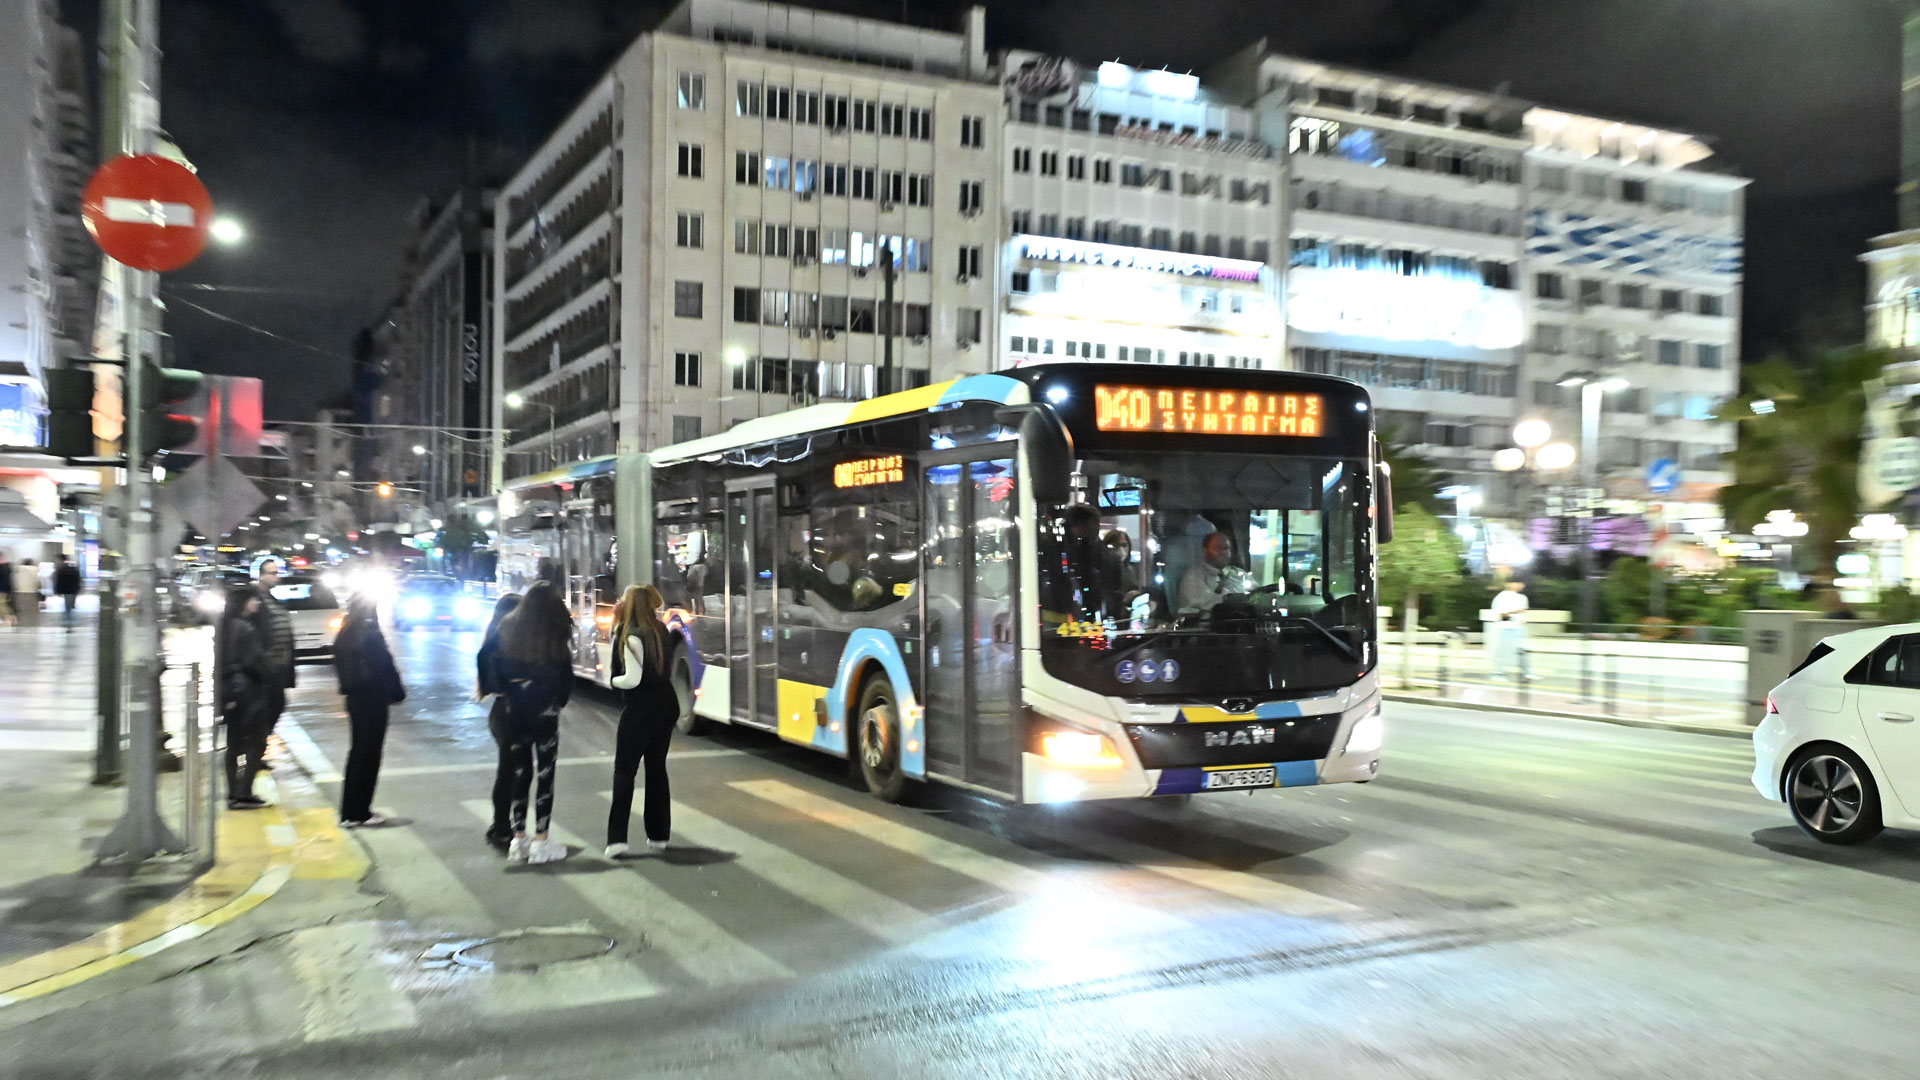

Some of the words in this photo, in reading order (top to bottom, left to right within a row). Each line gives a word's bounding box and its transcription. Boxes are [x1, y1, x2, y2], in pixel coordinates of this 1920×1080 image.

[1158, 390, 1318, 415] ΠΕΙΡΑΙΑΣ
[1162, 411, 1316, 434] ΣΥΝΤΑΓΜΑ
[1204, 725, 1275, 747] MAN
